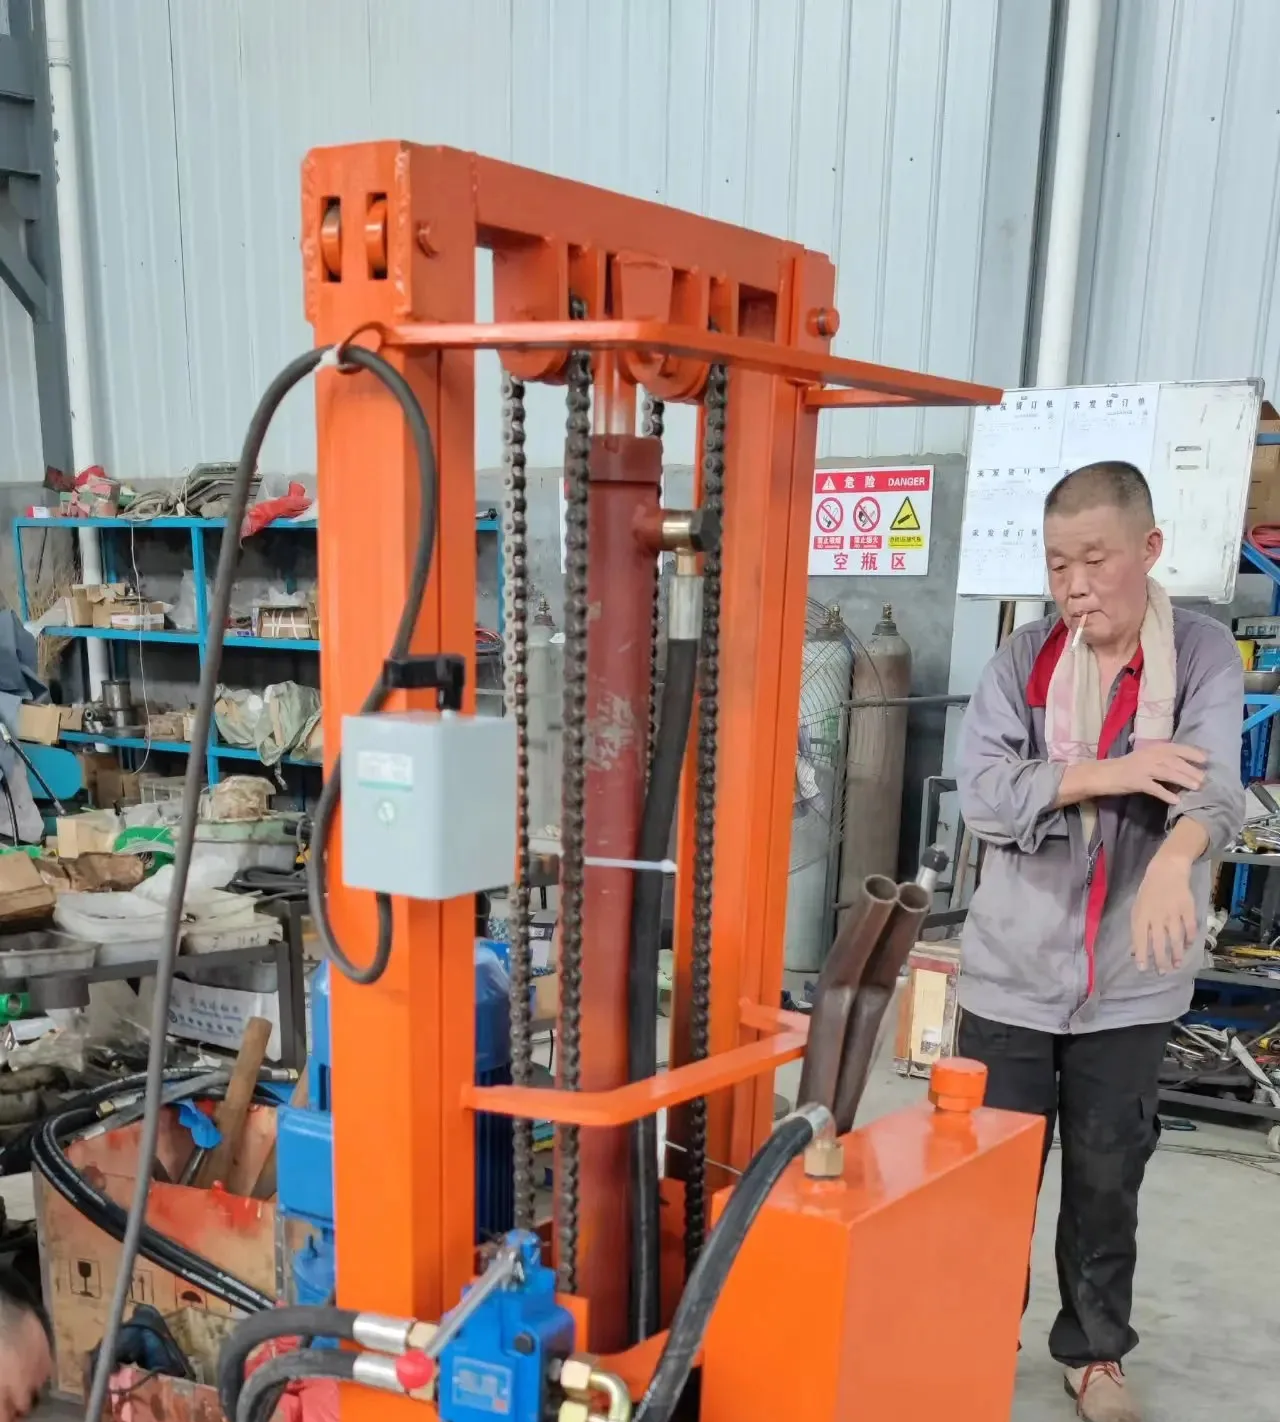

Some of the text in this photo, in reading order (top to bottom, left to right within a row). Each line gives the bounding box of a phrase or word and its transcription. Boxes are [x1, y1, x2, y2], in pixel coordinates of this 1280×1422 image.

[844, 475, 875, 488] 危险
[888, 476, 926, 487] DANGER
[833, 552, 906, 571] 空瓶区
